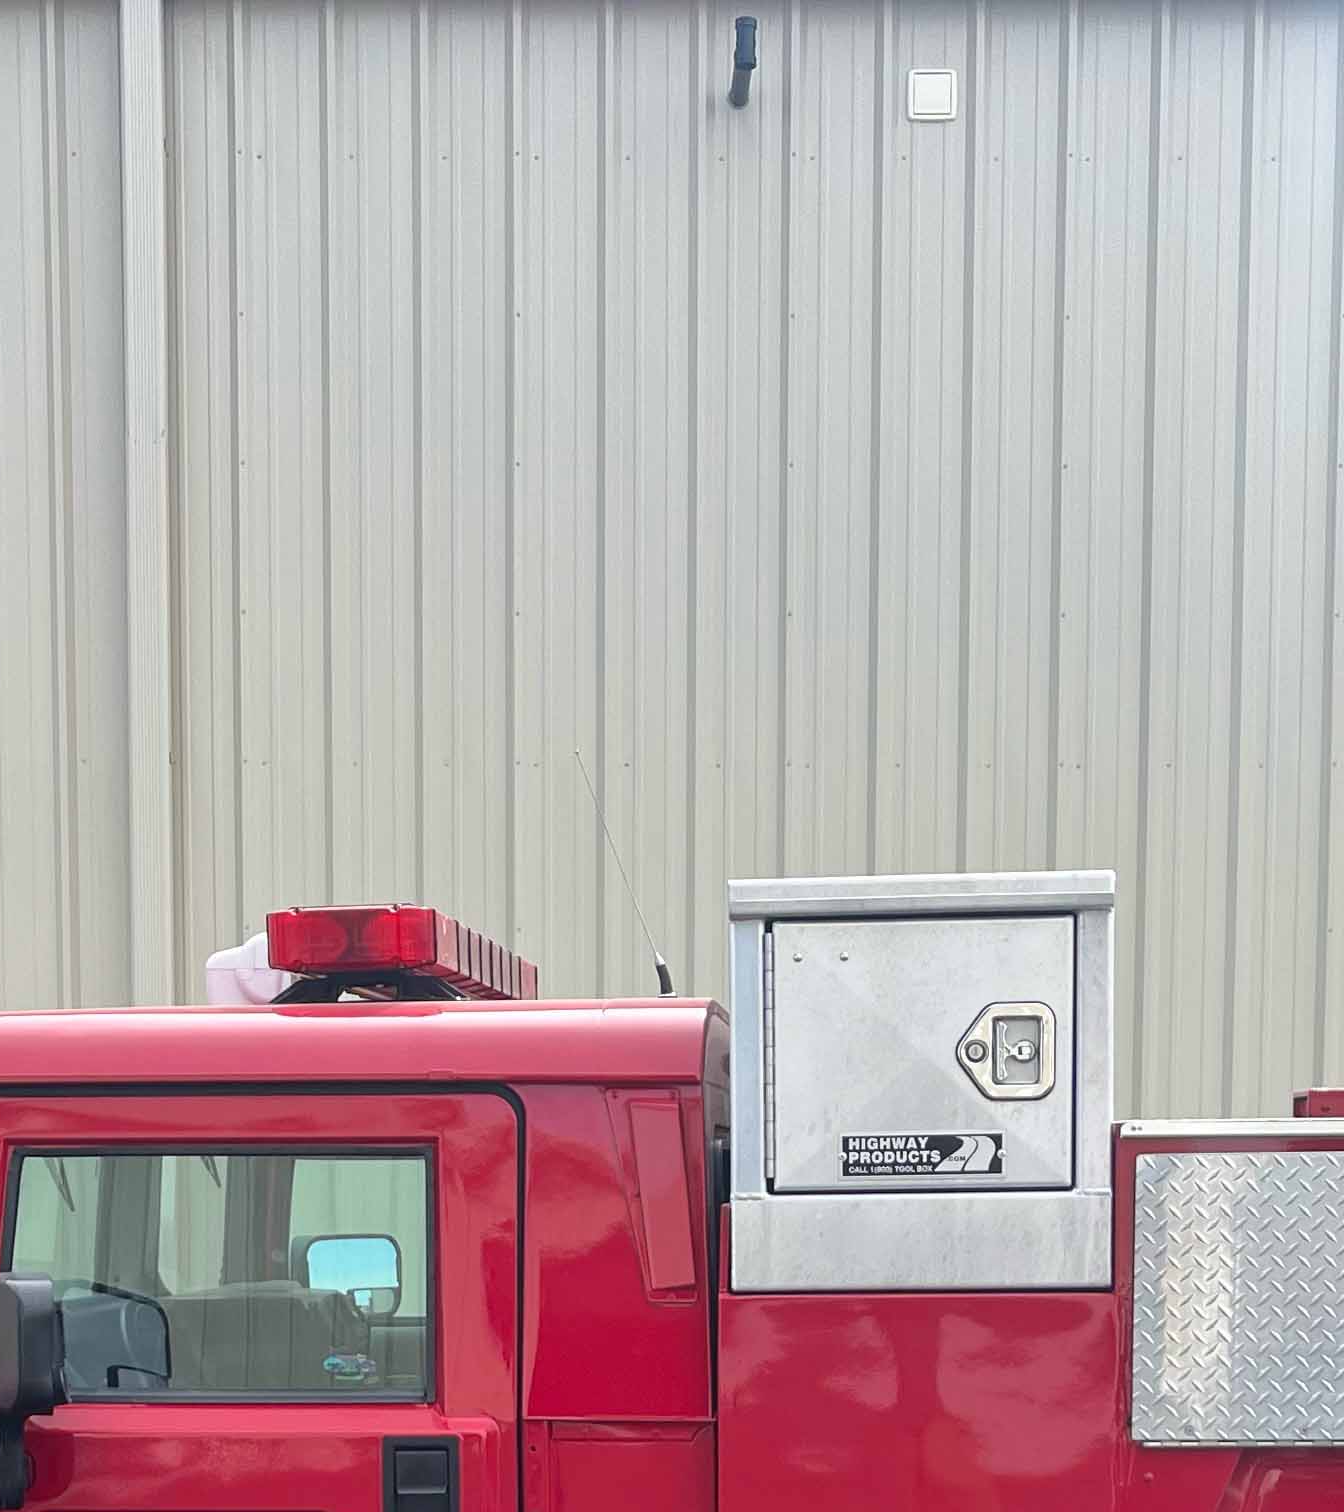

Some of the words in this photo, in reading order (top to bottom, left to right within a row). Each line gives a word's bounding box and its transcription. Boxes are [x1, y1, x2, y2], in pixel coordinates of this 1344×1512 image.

[848, 1136, 929, 1150] HIGHWAY
[848, 1150, 942, 1164] PRODUCTS
[848, 1165, 868, 1174] CALL
[894, 1165, 916, 1173] TOOL
[916, 1164, 934, 1173] BOX
